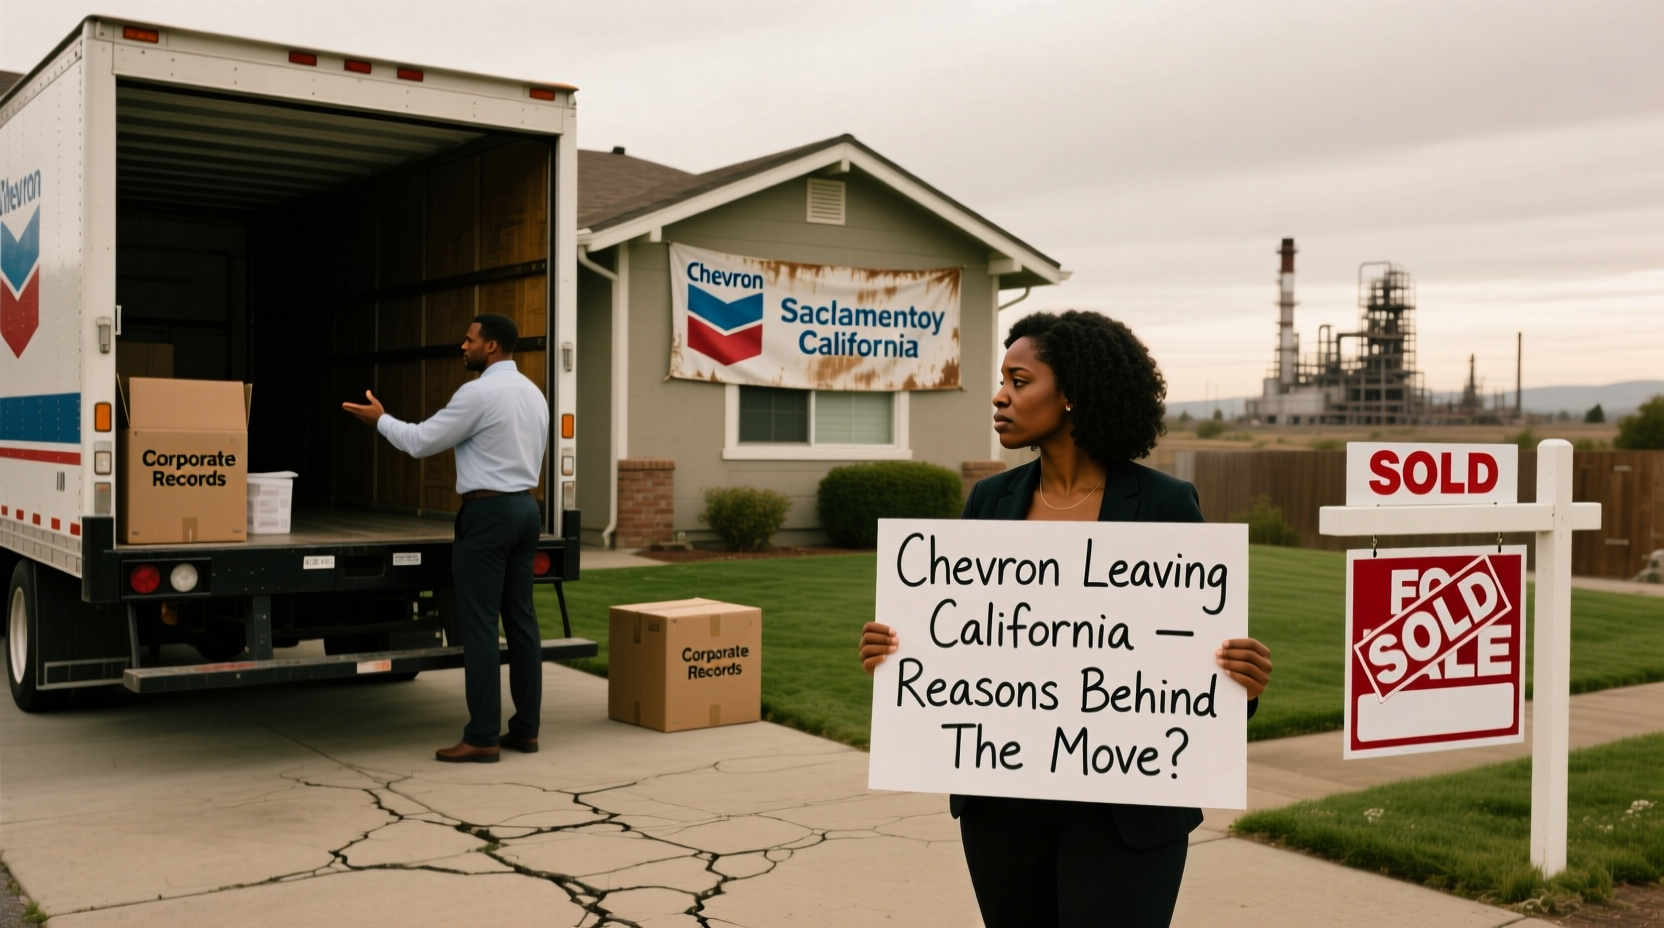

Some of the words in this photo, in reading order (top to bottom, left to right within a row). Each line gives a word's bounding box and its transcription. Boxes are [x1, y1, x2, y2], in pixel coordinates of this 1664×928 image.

[0, 168, 41, 216] hevron
[687, 262, 763, 289] Chevron
[780, 297, 945, 336] Saclamentoy
[799, 330, 919, 358] California
[142, 449, 236, 470] Corporate
[152, 470, 226, 487] Records
[1369, 450, 1498, 495] SOLD
[897, 532, 1059, 587] Chevron
[1083, 538, 1228, 615] Leaving
[929, 598, 1134, 650] California
[1369, 571, 1498, 684] SOLD
[682, 645, 749, 663] Corporate
[688, 662, 742, 680] Records
[897, 657, 1059, 710] Reasons
[1080, 666, 1217, 718] Behind
[941, 723, 1023, 770] The
[1050, 726, 1189, 779] Move?
